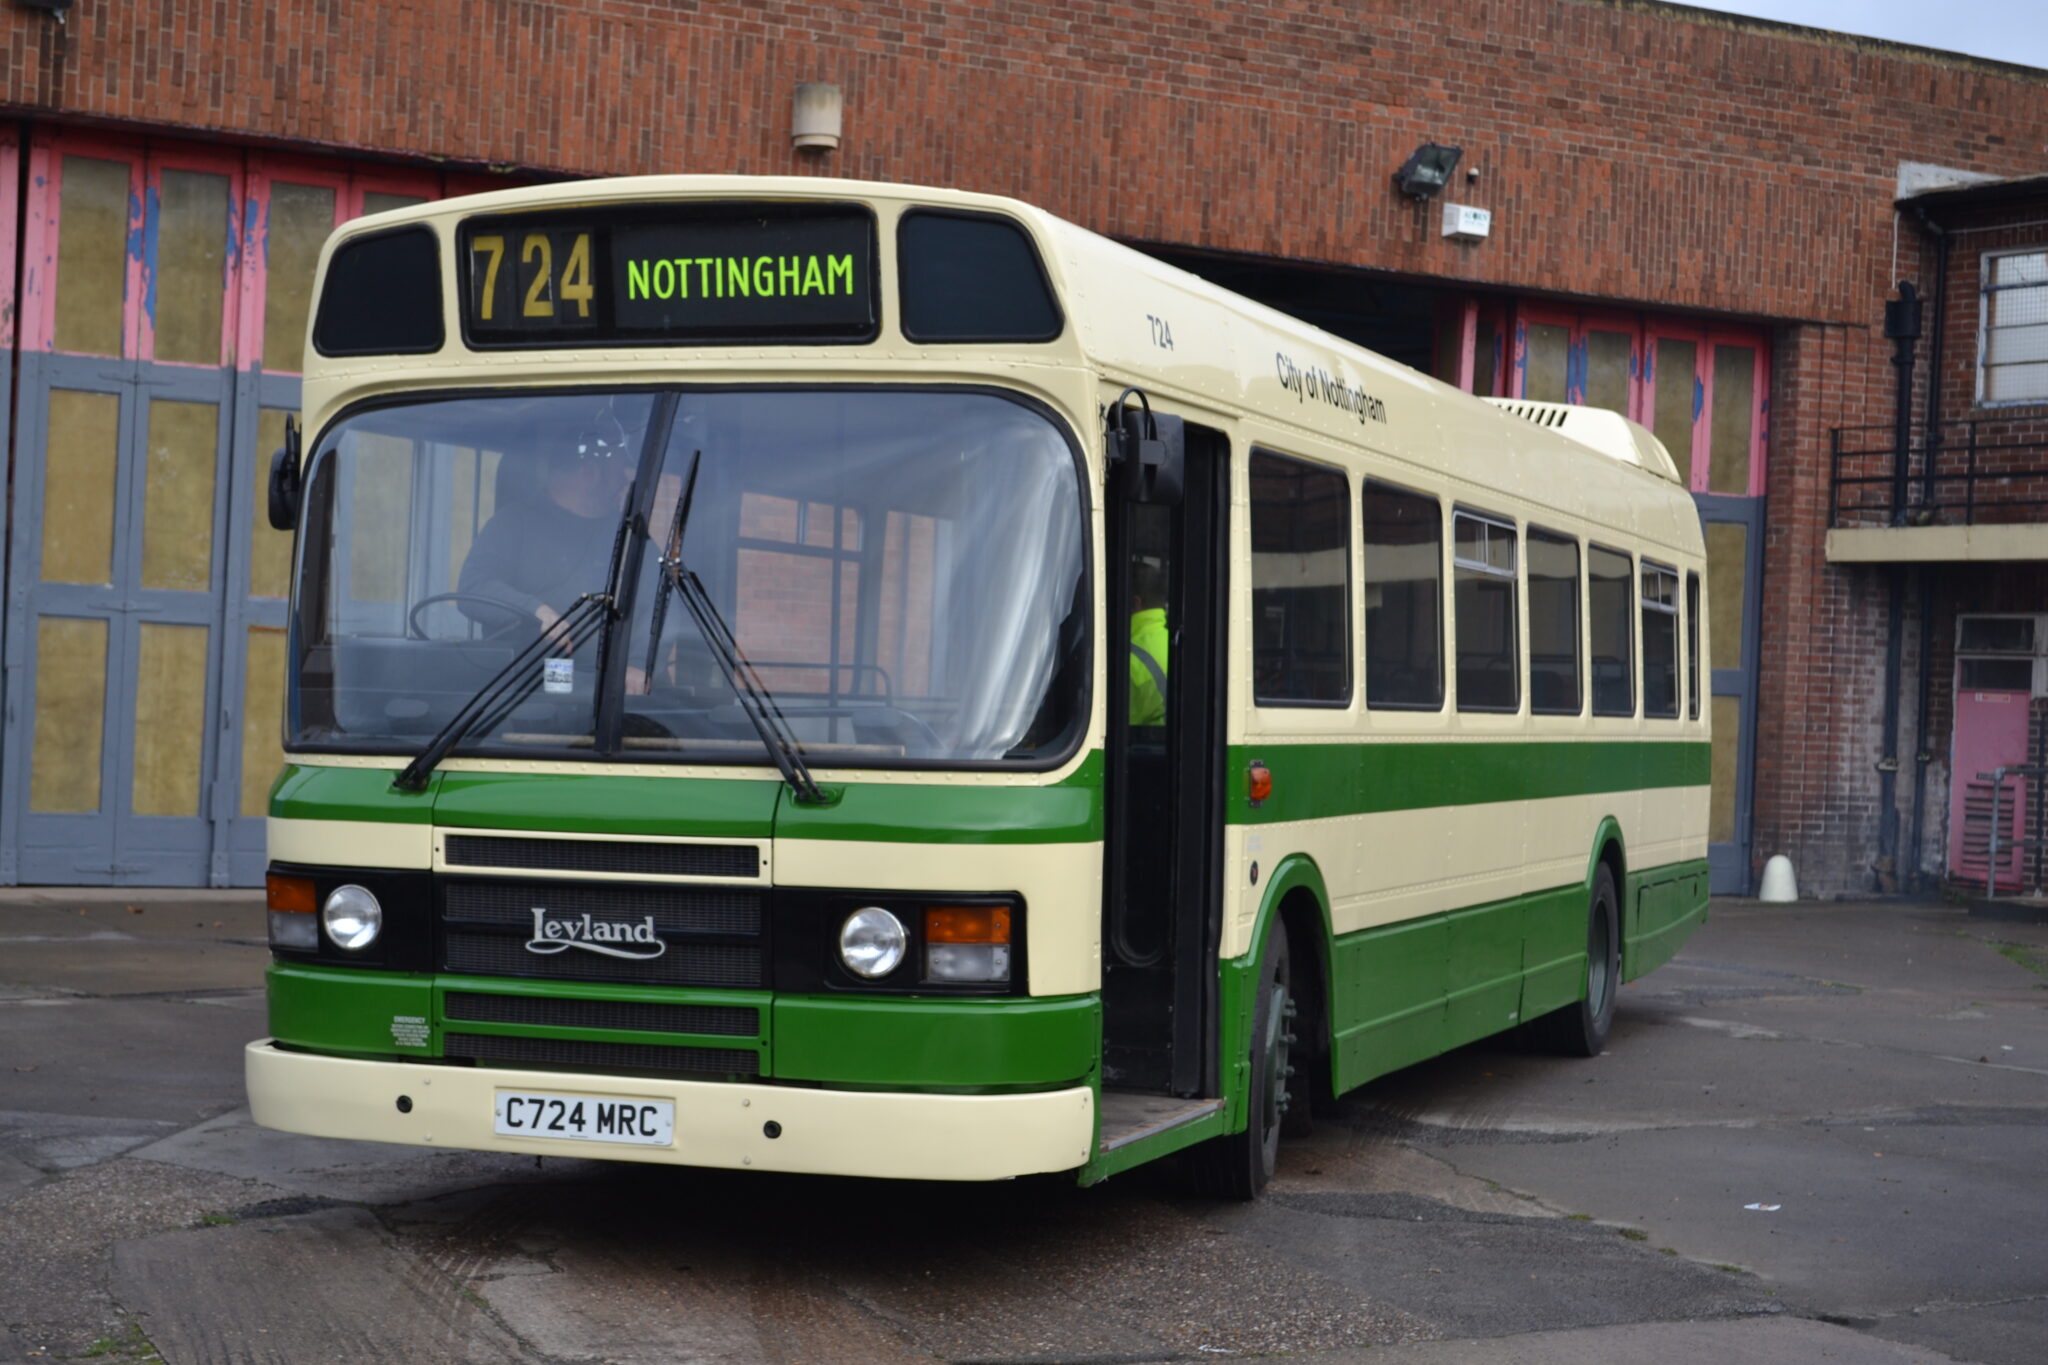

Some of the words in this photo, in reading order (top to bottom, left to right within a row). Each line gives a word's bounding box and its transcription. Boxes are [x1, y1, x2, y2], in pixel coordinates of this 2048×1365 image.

[473, 234, 593, 319] 724
[628, 254, 853, 299] NOTTINGHAM
[1147, 314, 1173, 351] 724
[1276, 352, 1302, 403] City
[1306, 366, 1318, 400] of
[1319, 369, 1386, 425] Nottingham
[525, 908, 666, 959] Leyland
[506, 1097, 586, 1132] C724
[597, 1103, 657, 1137] MRC
